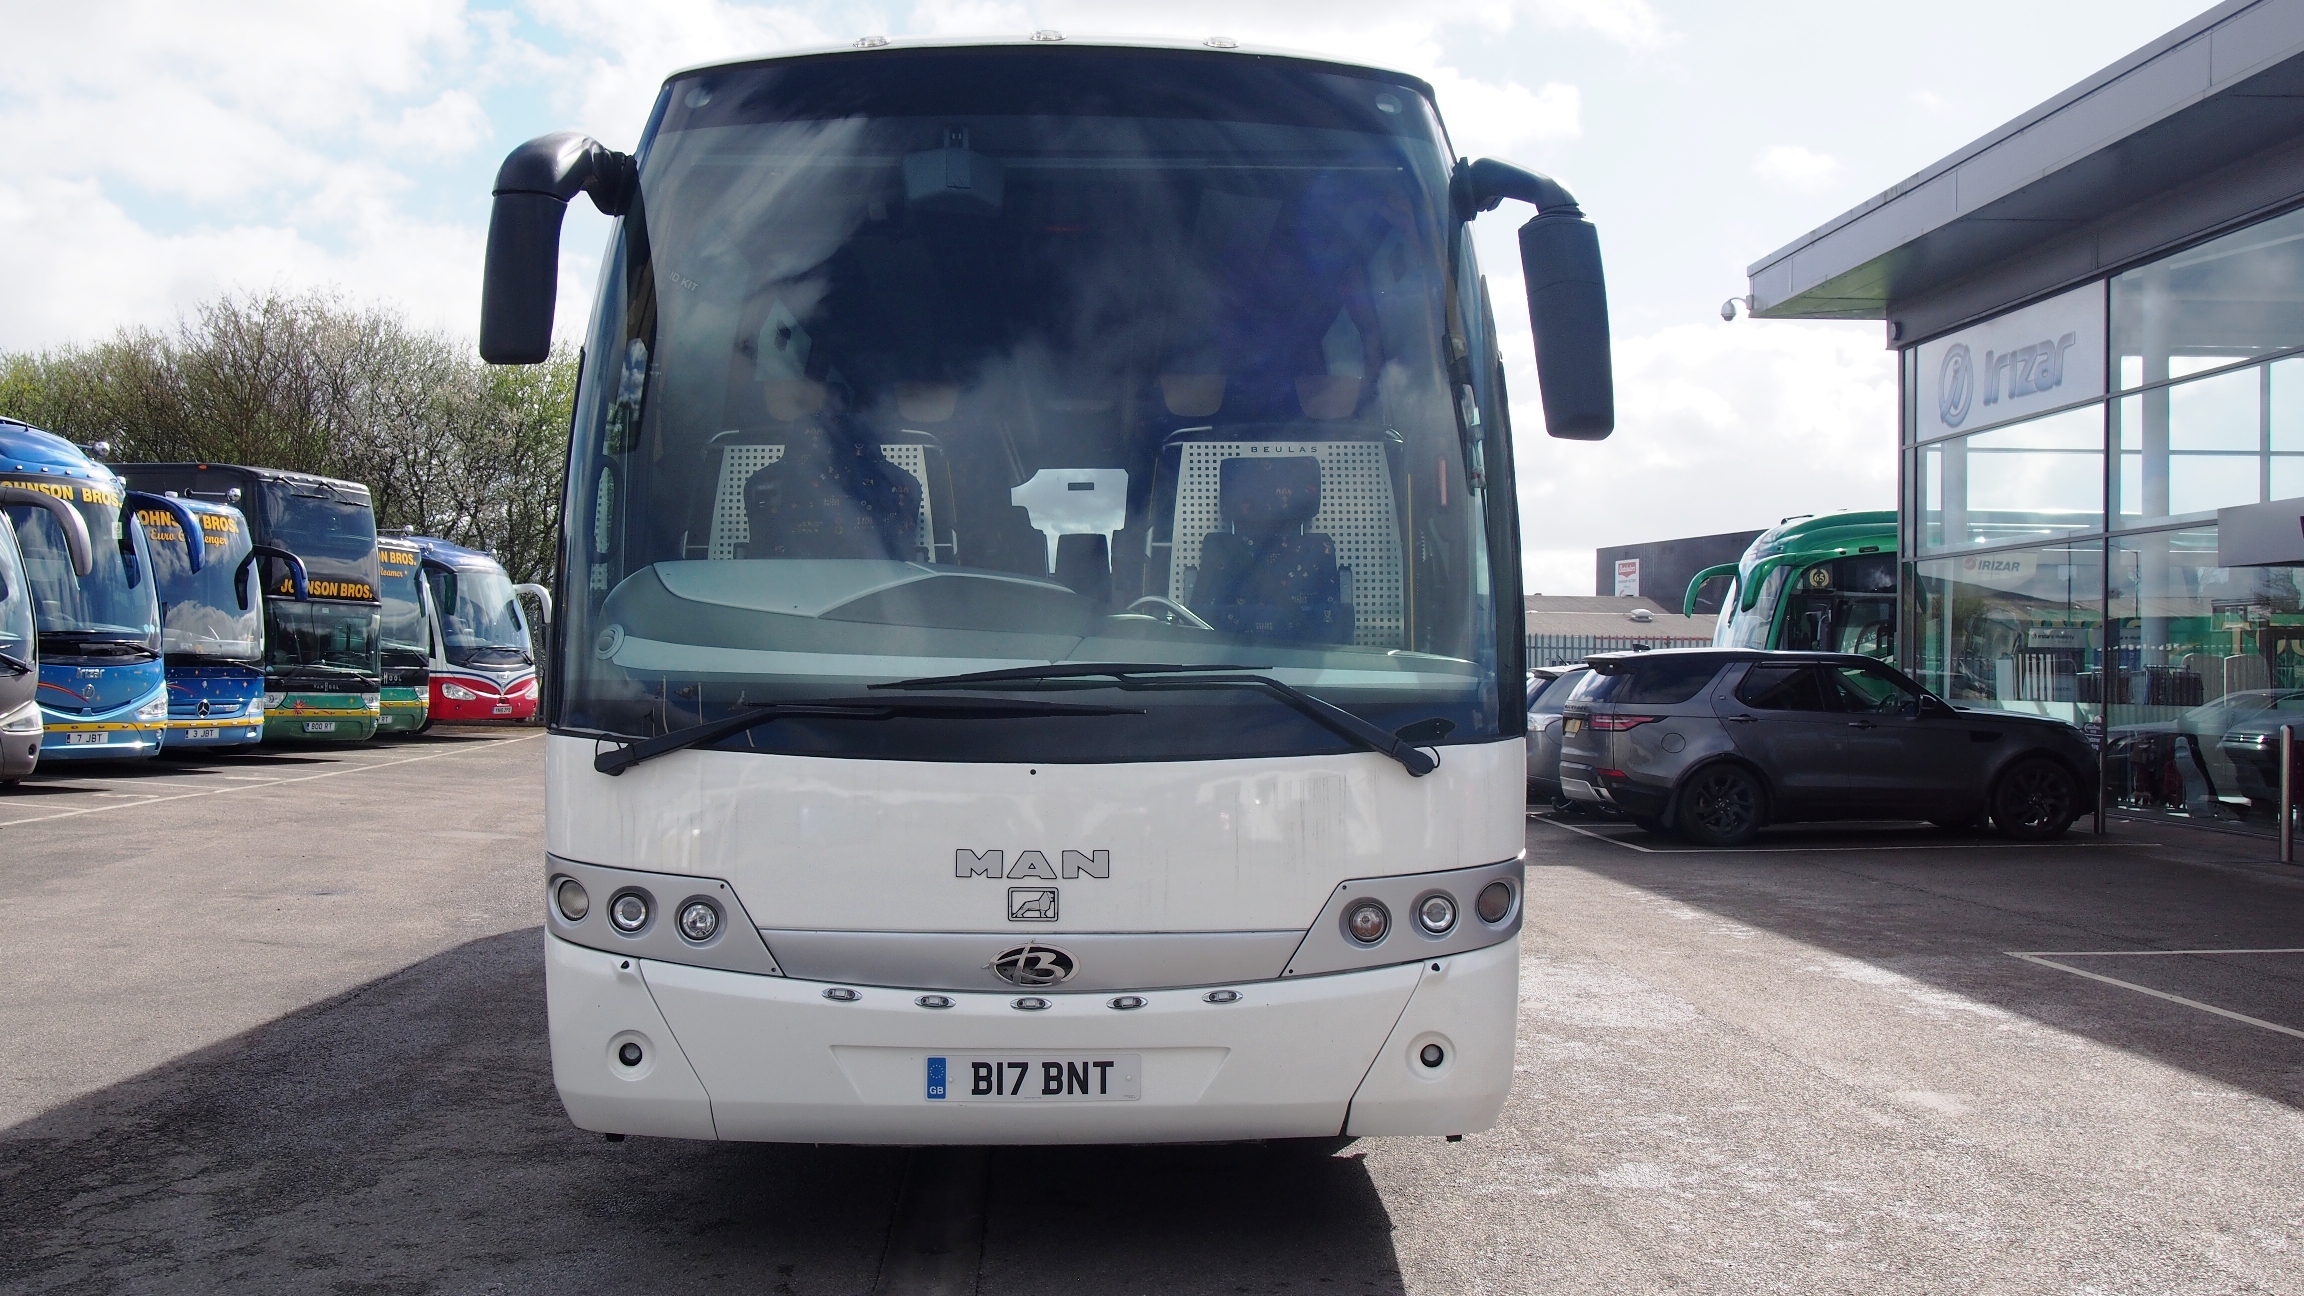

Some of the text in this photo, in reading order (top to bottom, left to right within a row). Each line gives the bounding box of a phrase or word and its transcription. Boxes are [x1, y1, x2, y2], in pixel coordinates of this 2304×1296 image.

[667, 269, 699, 292] ID KIT
[0, 481, 123, 508] NSON BROS.
[138, 510, 239, 533] OHNS BROS.
[150, 528, 175, 541] Euro
[389, 551, 417, 566] BROS.
[1978, 560, 2020, 571] IRIZAR
[1814, 573, 1825, 582] 65
[281, 579, 373, 599] JONSON BROS.
[324, 722, 333, 730] RT
[77, 733, 103, 743] 7 JBT
[193, 729, 214, 738] 3 JBT
[955, 849, 1110, 879] MAN
[971, 1061, 1114, 1096] B17 BNT
[929, 1086, 944, 1095] GB
